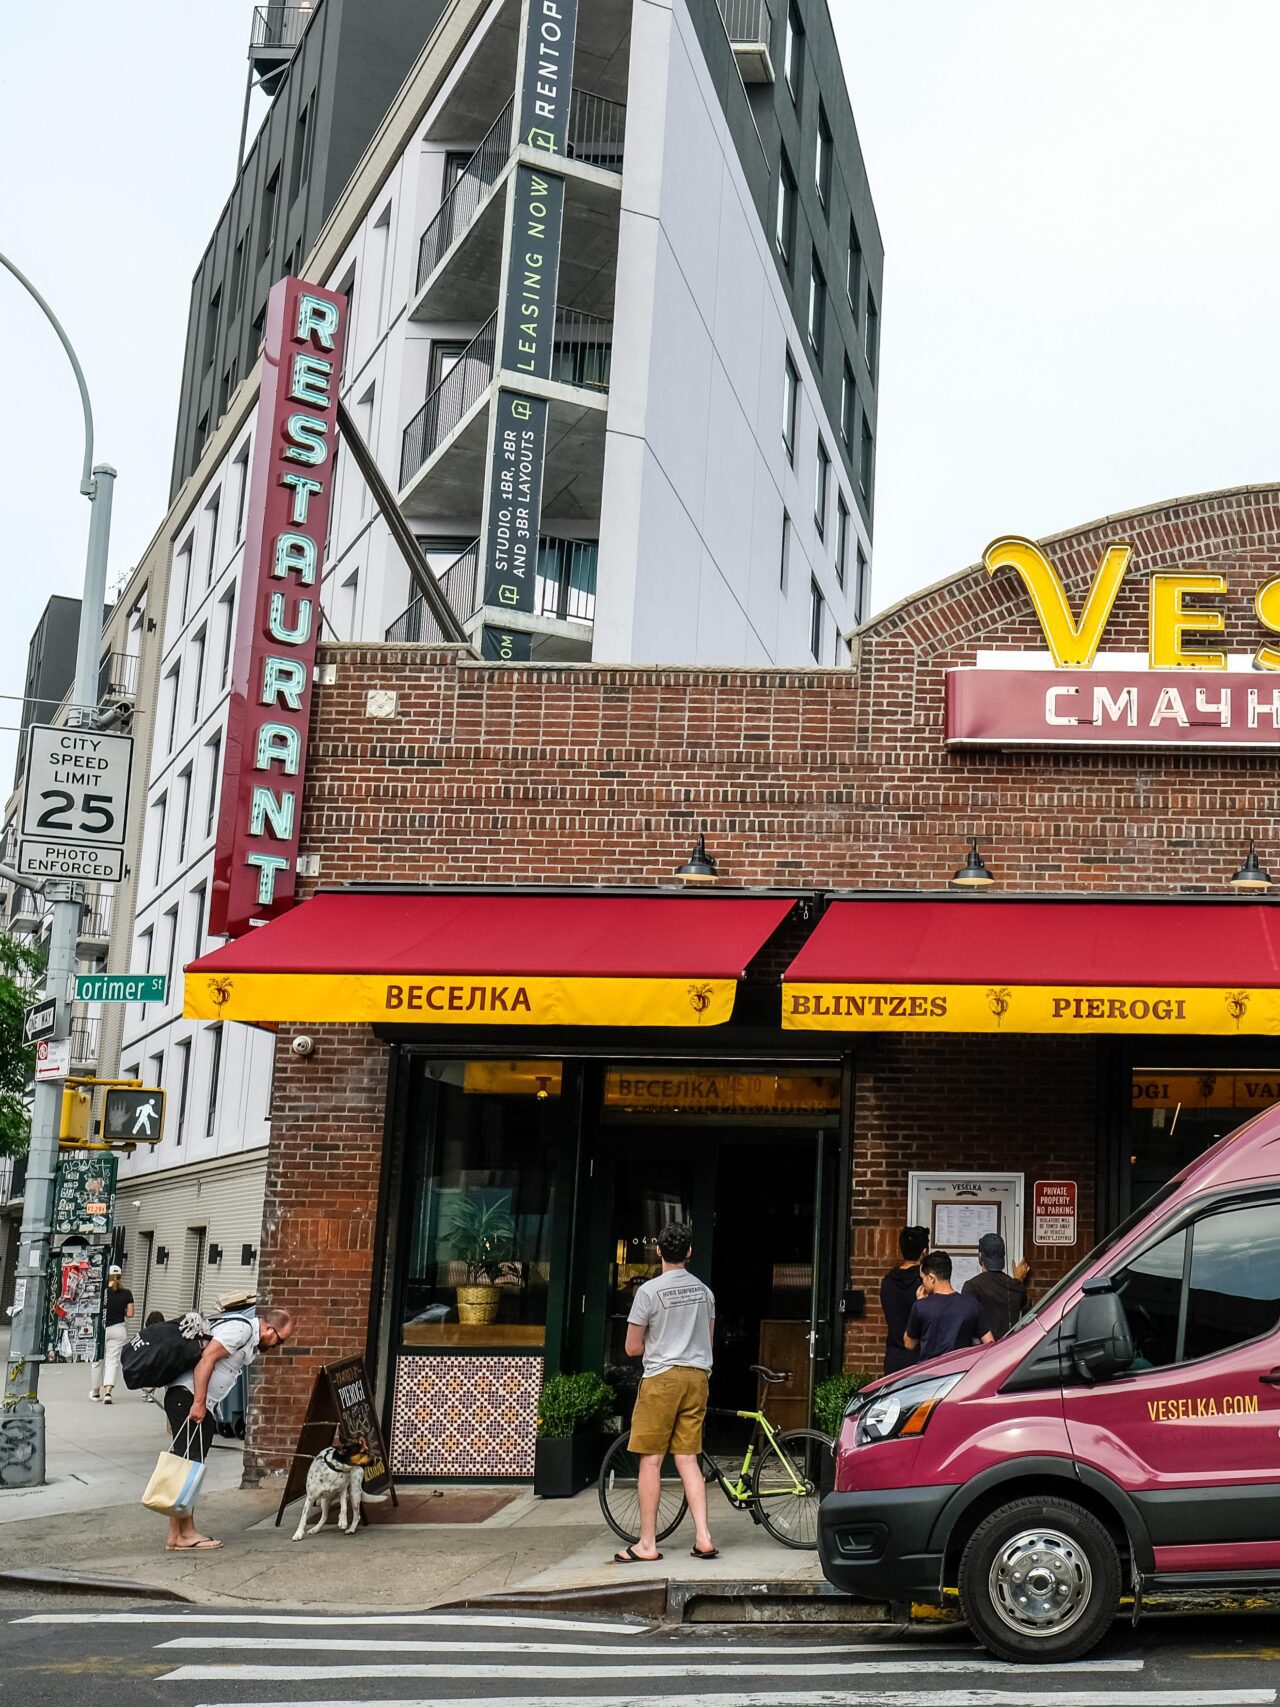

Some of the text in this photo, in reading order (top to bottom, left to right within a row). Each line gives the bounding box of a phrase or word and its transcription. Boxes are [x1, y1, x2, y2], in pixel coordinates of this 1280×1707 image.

[516, 175, 550, 372] LEASING NOW
[496, 430, 517, 571] STUDIO, 1BR, 2BR
[512, 430, 534, 579] AND 3BR LAYOUTS
[248, 291, 341, 906] RESTAURANT
[60, 736, 102, 752] CITY
[49, 752, 109, 770] SPEED
[54, 770, 102, 787] LIMIT
[36, 789, 115, 834] 25
[45, 847, 98, 862] PHOTO
[28, 859, 114, 876] ENFORCED
[74, 976, 162, 1000] Lorimer St
[385, 985, 532, 1012] ВЕСЕЛКА
[790, 994, 948, 1017] BLINTZES
[1052, 998, 1187, 1020] PIEROGI
[952, 1184, 982, 1192] VESELKA
[1043, 1187, 1068, 1195] PRIVATE
[1036, 1206, 1074, 1214] NO PARKING
[1040, 1196, 1070, 1205] PROPERTY
[338, 1380, 366, 1409] PIEROGI
[1147, 1394, 1259, 1421] VESELKA.COM
